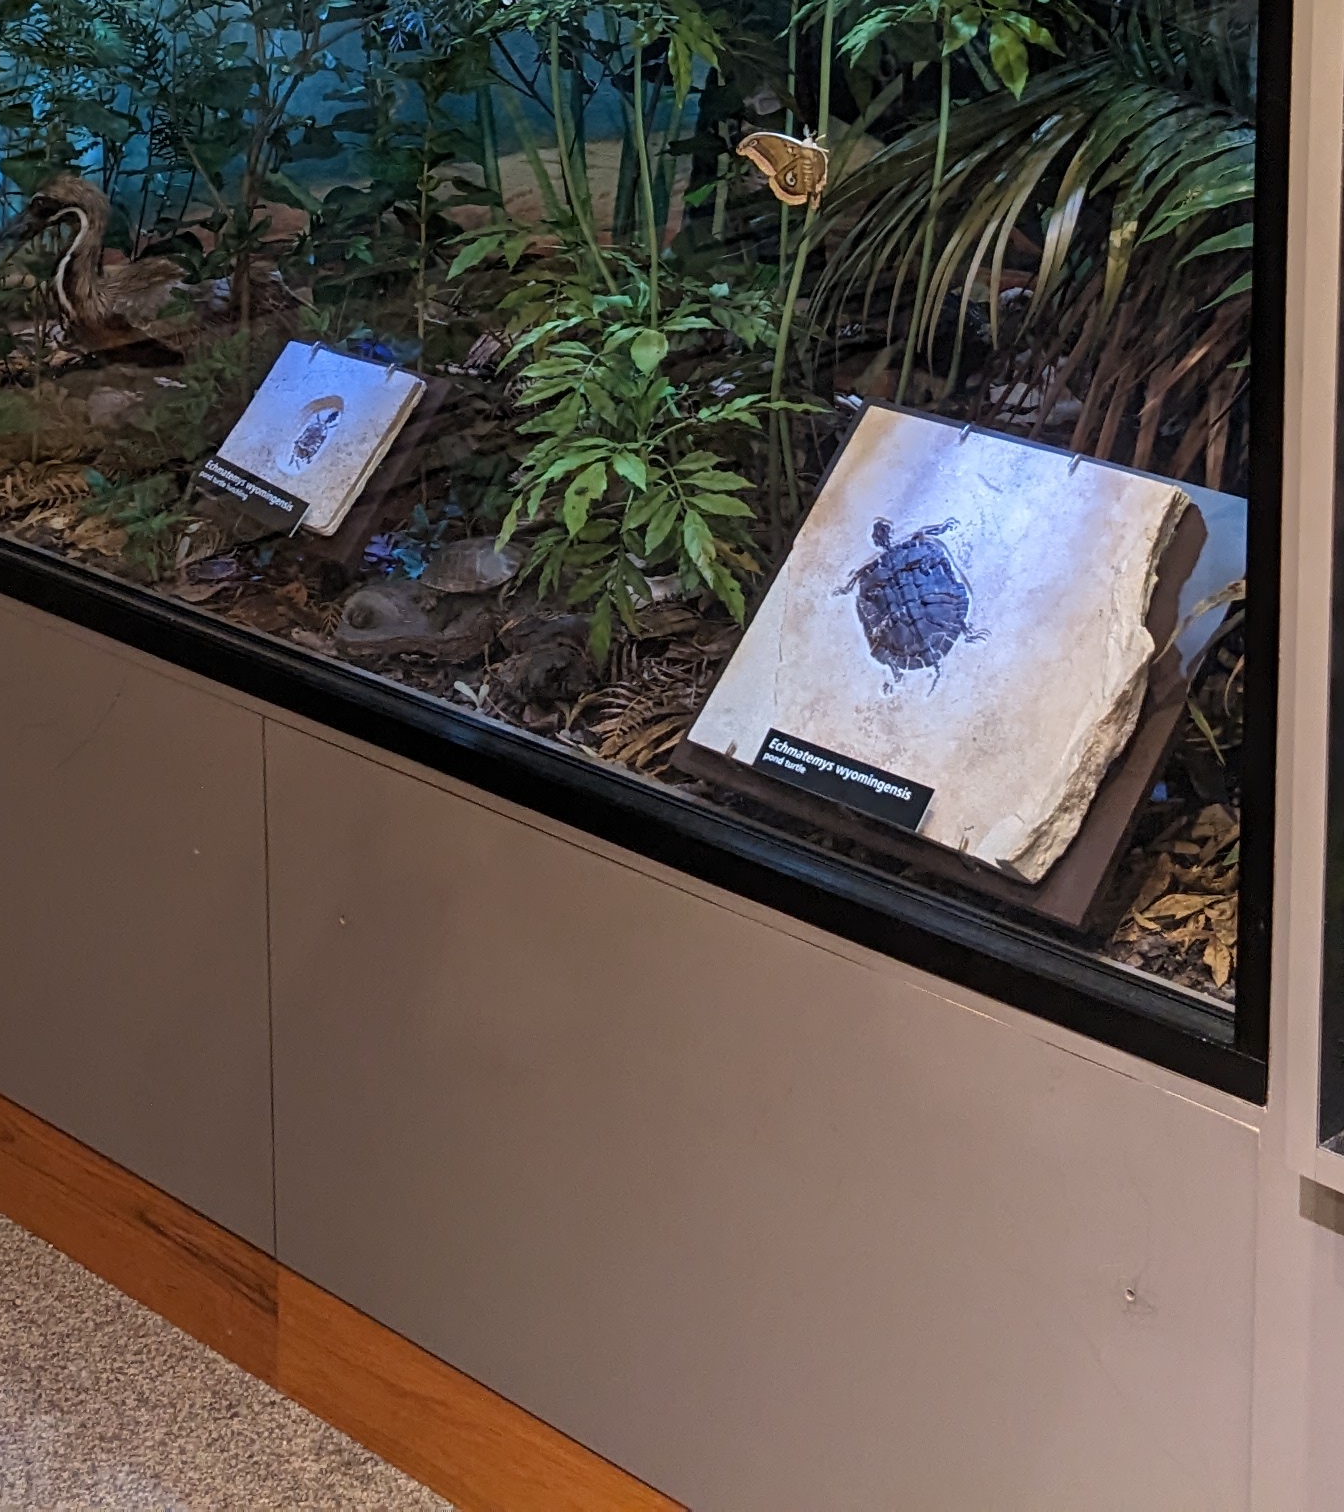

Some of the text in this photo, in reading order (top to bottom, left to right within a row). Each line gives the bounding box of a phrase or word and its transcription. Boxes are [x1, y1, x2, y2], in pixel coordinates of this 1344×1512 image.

[762, 752, 806, 774] pond turtle
[769, 738, 912, 800] Echmatemys wyomingensis
